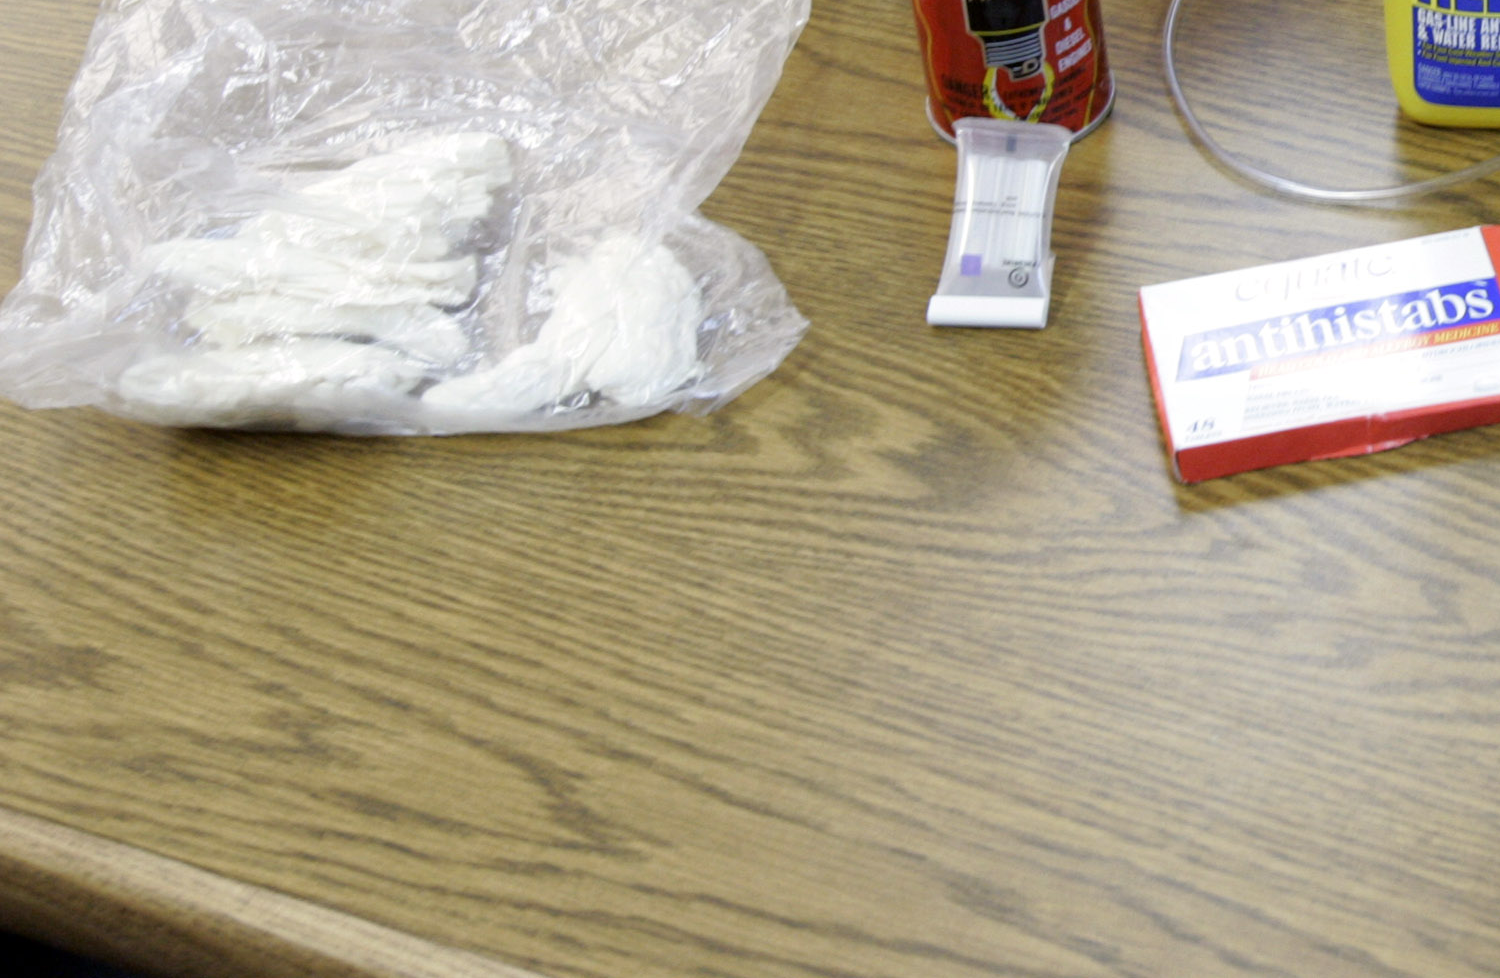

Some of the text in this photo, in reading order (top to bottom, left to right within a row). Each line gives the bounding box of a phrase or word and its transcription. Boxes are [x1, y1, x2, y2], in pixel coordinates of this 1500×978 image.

[1417, 7, 1477, 33] GAS-LINE
[1432, 26, 1477, 50] WATER
[1235, 254, 1396, 303] equate
[1191, 284, 1495, 372] antihistabs
[1433, 322, 1499, 344] MEDICINE
